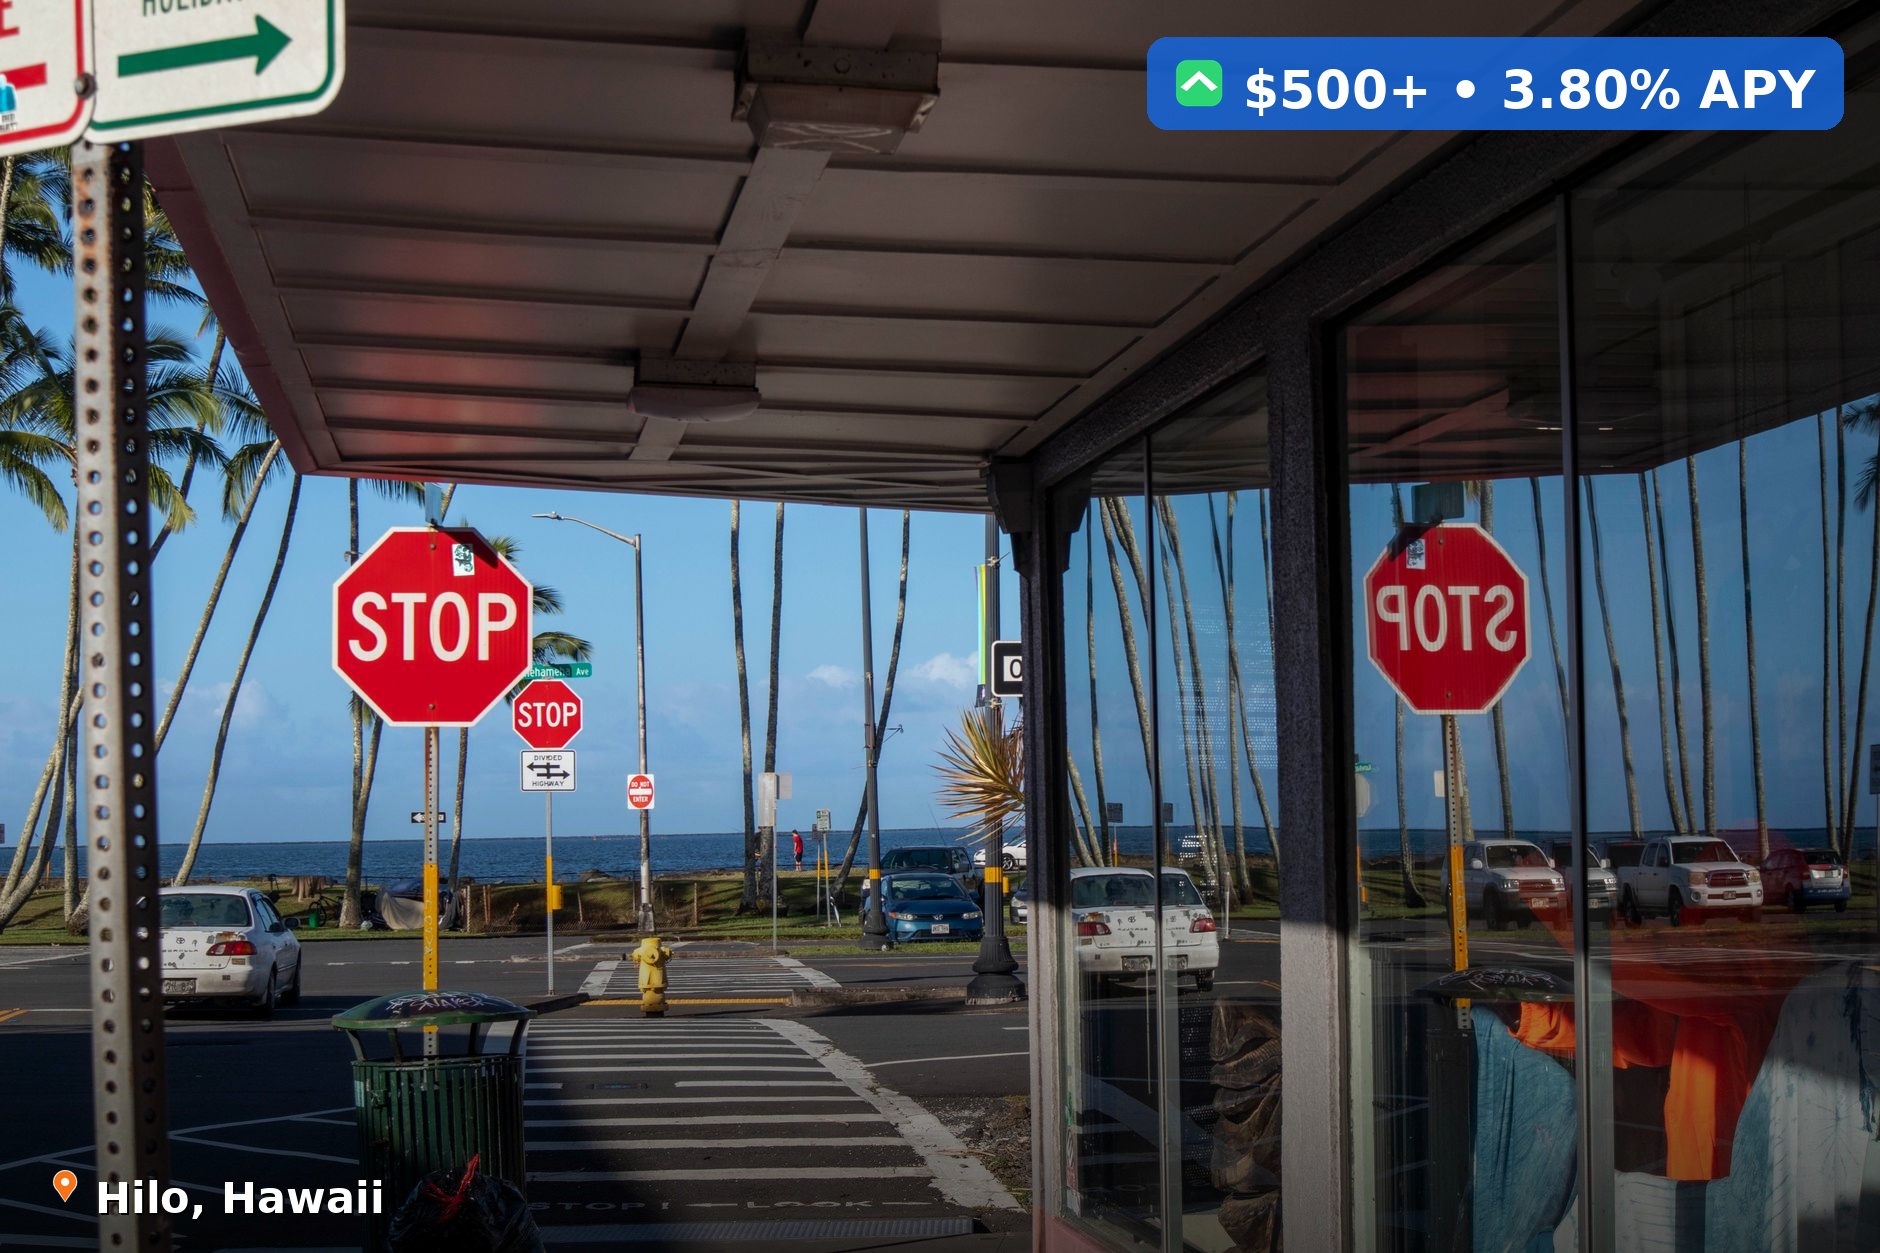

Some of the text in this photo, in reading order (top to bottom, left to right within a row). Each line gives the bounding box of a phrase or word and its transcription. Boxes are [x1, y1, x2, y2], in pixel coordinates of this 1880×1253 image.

[348, 591, 518, 662] STOP
[575, 667, 589, 676] Ave
[518, 702, 578, 728] STOP
[640, 780, 650, 788] NOT
[746, 1200, 873, 1209] LOOK
